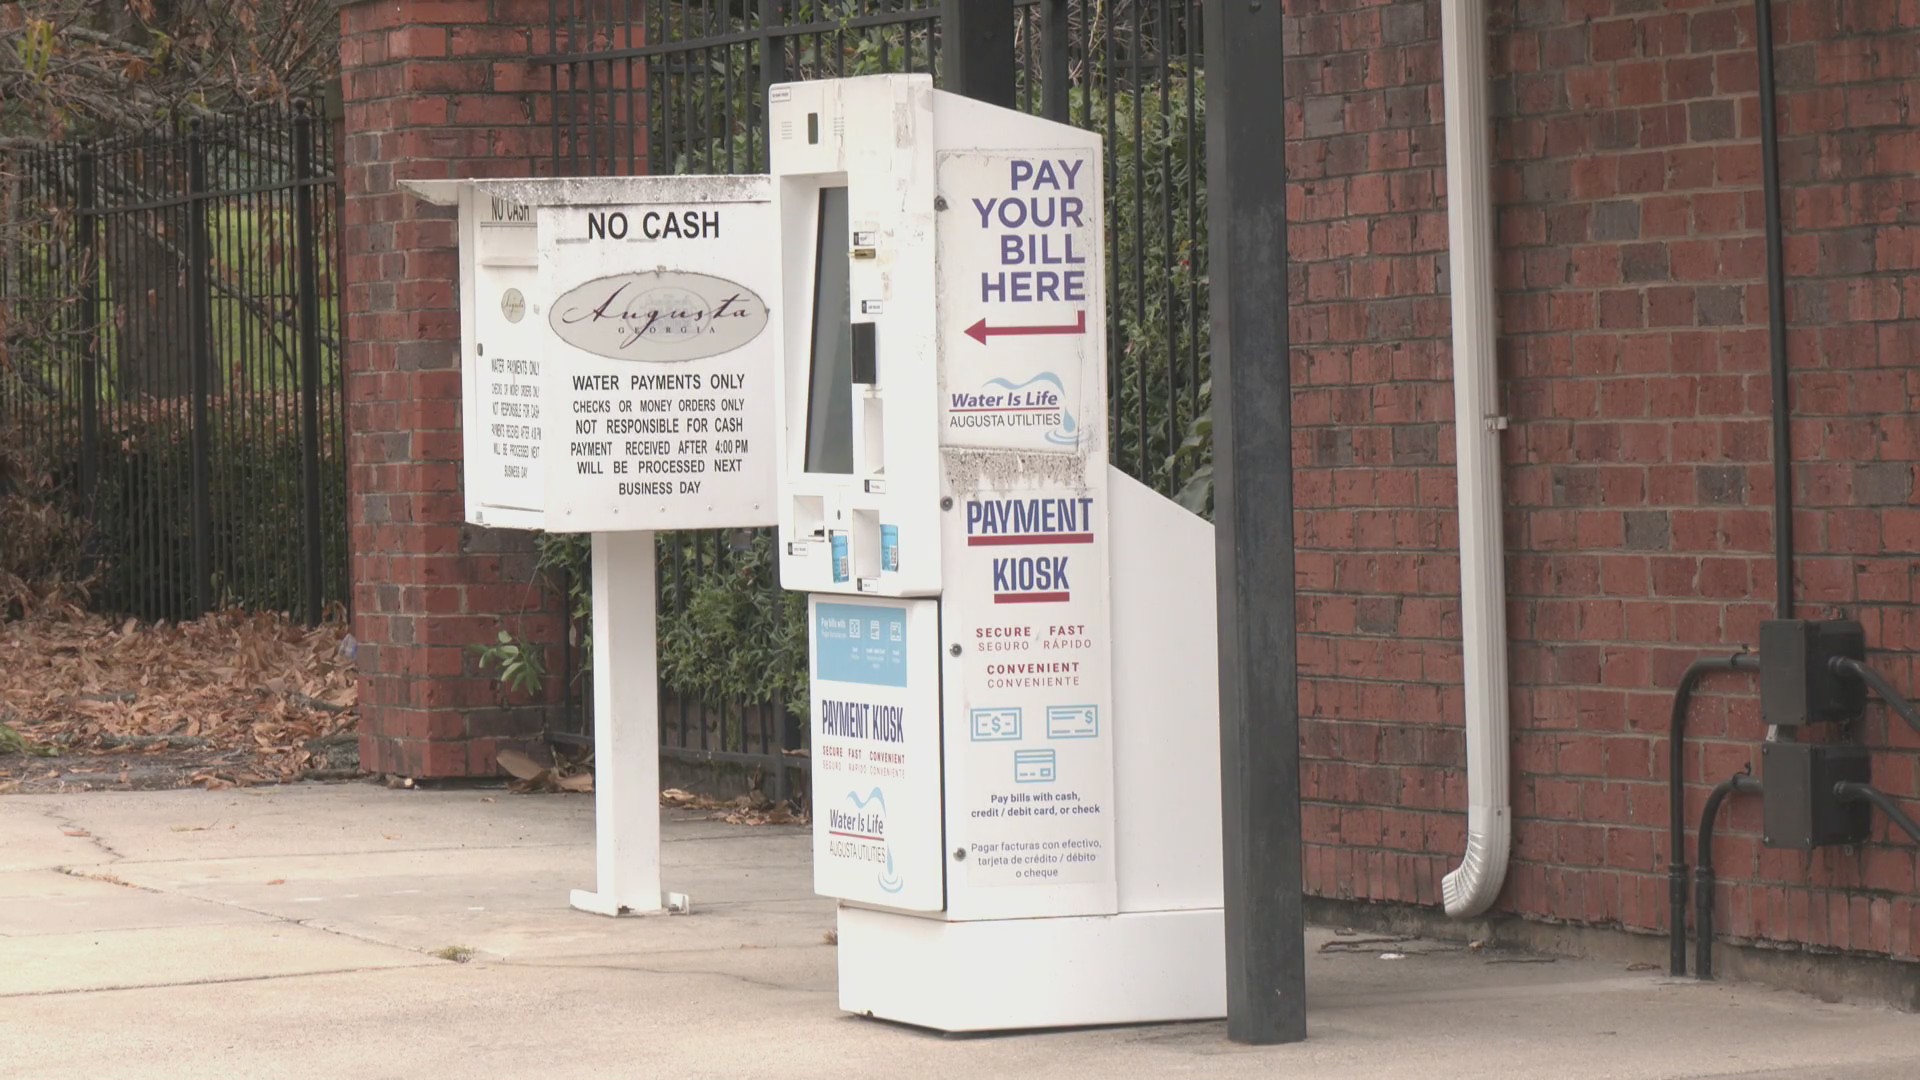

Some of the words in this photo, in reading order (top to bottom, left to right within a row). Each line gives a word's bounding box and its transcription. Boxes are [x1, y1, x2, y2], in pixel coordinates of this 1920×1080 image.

[1010, 159, 1084, 191] PAY
[491, 196, 503, 221] NO
[507, 197, 529, 222] CASH
[971, 196, 1084, 229] YOUR
[588, 211, 628, 240] NO
[643, 211, 720, 240] CASH
[1000, 233, 1085, 265] BILL
[981, 270, 1085, 303] HERE
[562, 281, 751, 349] Augusta
[618, 326, 716, 334] GEORGIA
[572, 375, 620, 391] WATER
[631, 374, 701, 390] PAYMENTS
[710, 373, 745, 389] ONLY
[572, 400, 611, 413] CHECKS
[618, 400, 632, 412] OR
[639, 399, 672, 412] MONEY
[678, 399, 716, 412] ORDERS
[721, 398, 745, 411] ONLY
[951, 393, 1003, 408] Water
[1007, 392, 1021, 407] Is
[1025, 391, 1058, 406] Life
[575, 419, 597, 434] NOT
[606, 418, 679, 434] RESPONSIBLE
[687, 417, 708, 433] FOR
[714, 417, 743, 432] CASH
[950, 415, 1005, 428] AUGUSTA
[1007, 413, 1061, 427] UTILITIES
[570, 441, 612, 457] PAYMENT
[625, 441, 671, 455] RECEIVED
[678, 440, 708, 454] AFTER
[715, 440, 733, 454] 4:00
[735, 439, 749, 454] PM
[577, 461, 604, 475] WILL
[613, 461, 628, 474] BE
[638, 459, 705, 474] PROCESSED
[714, 459, 743, 472] NEXT
[618, 482, 673, 495] BUSINESS
[679, 481, 701, 494] DAY
[966, 498, 1094, 535] PAYMENT
[993, 556, 1070, 591] KIOSK
[975, 626, 1032, 638] SECURE
[1049, 625, 1085, 636] FAST
[978, 640, 1029, 652] SEGURO
[1043, 638, 1092, 650] RÁPIDO
[986, 662, 1080, 675] CONVENIENT
[987, 676, 1080, 689] CONVENIENTE
[821, 699, 869, 740] PAYMENT
[872, 704, 904, 743] KIOSK
[822, 745, 843, 757] SECURE
[848, 748, 862, 760] FAST
[869, 750, 905, 764] CONVENIENT
[990, 793, 1008, 805] Pay
[1010, 792, 1031, 803] bills
[1032, 792, 1053, 802] with
[1055, 791, 1081, 802] cash,
[971, 807, 999, 818] credit
[1007, 806, 1031, 817] debit
[1034, 805, 1058, 816] card,
[1060, 806, 1070, 814] or
[1072, 804, 1101, 814] check
[829, 809, 856, 830] Water
[857, 812, 865, 832] Is
[867, 814, 884, 834] Life
[829, 840, 858, 860] AUGUSTA
[858, 844, 886, 864] UTILITIES
[971, 842, 999, 854] Pagar
[1001, 841, 1040, 851] facturas
[1042, 842, 1060, 850] con
[978, 856, 1009, 867] tarjeta
[1010, 855, 1022, 865] de
[1024, 853, 1058, 864] crédito
[1066, 852, 1096, 863] débito
[1015, 870, 1022, 879] o
[1023, 868, 1059, 880] cheque
